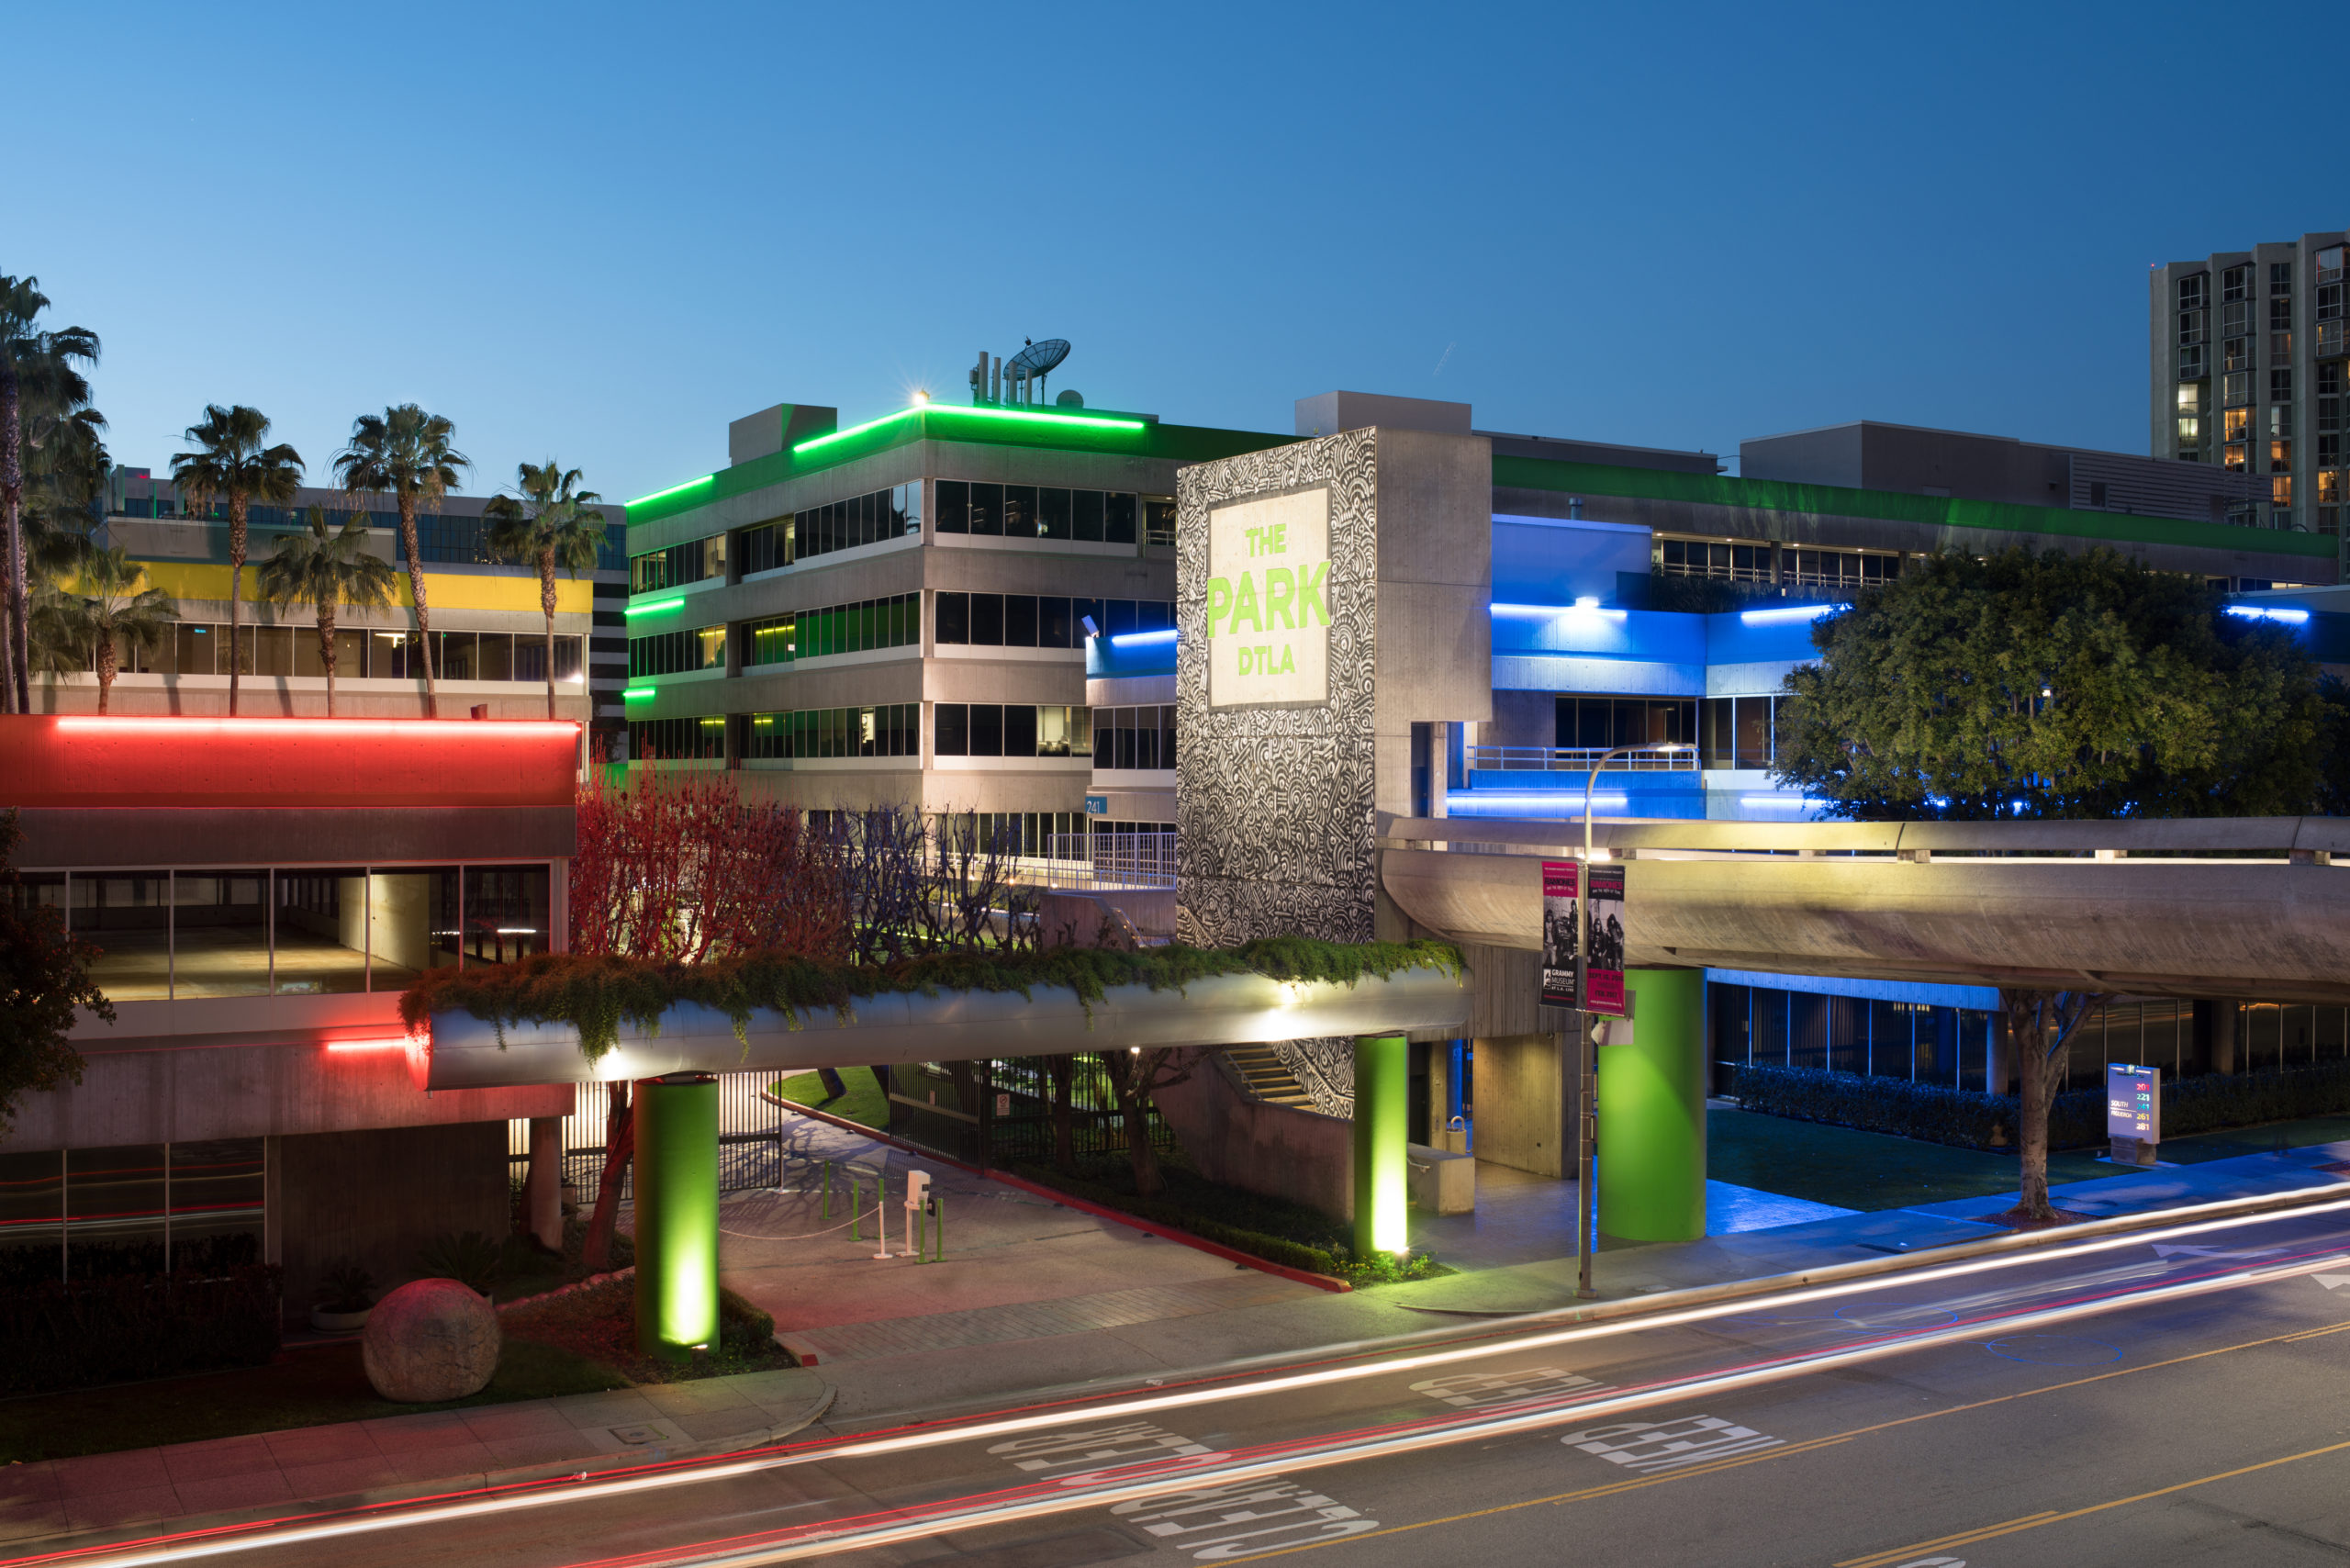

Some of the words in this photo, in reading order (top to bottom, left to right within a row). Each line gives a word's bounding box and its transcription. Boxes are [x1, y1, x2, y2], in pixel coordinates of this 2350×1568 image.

[1245, 522, 1287, 557] THE
[1207, 559, 1331, 638] PARK
[1238, 644, 1295, 676] DTLA
[1087, 801, 1100, 814] 241
[1551, 969, 1574, 978] GRAMMY
[1551, 977, 1574, 985] MUSEUM
[2110, 1100, 2129, 1108] SOUTH
[2110, 1110, 2132, 1118] FIGUEROA
[2136, 1123, 2150, 1131] 281
[1408, 1366, 1619, 1414] KEEP
[1560, 1414, 1786, 1473] KEEP
[1109, 1475, 1380, 1560] CLEAR
